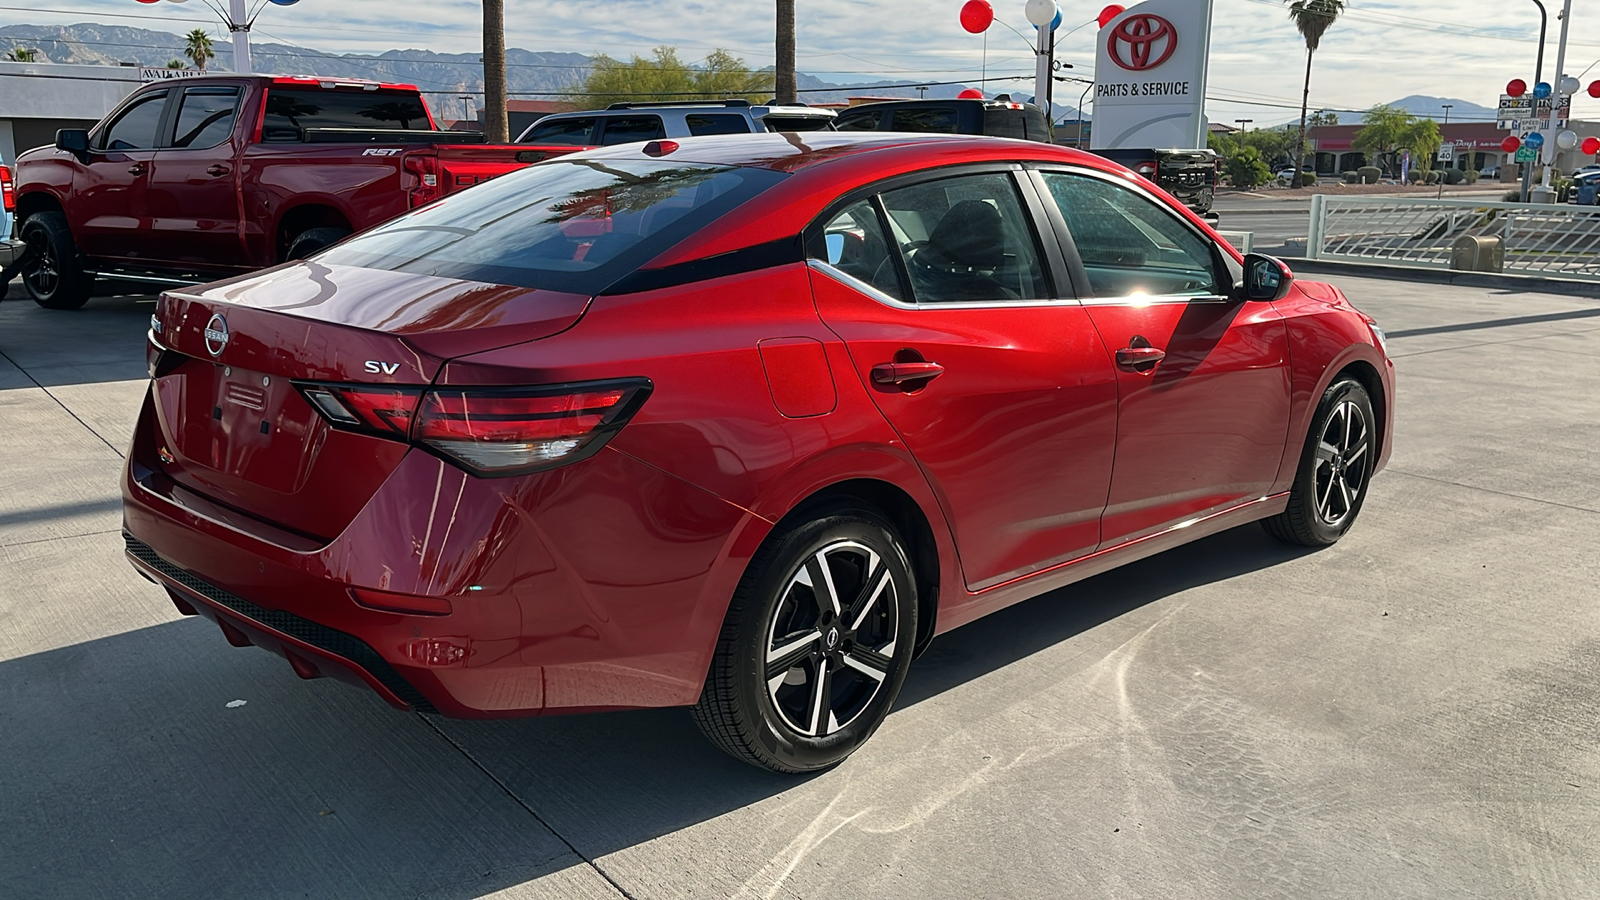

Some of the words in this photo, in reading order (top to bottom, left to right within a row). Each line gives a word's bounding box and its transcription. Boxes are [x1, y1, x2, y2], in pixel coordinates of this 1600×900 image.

[1097, 83, 1128, 97] PARTS
[1131, 83, 1139, 96] &
[1142, 81, 1189, 96] SERVICE
[1500, 99, 1529, 108] CHZE
[362, 148, 403, 156] RST
[1440, 152, 1451, 160] 40
[1178, 172, 1206, 185] RAM
[364, 360, 401, 376] SV
